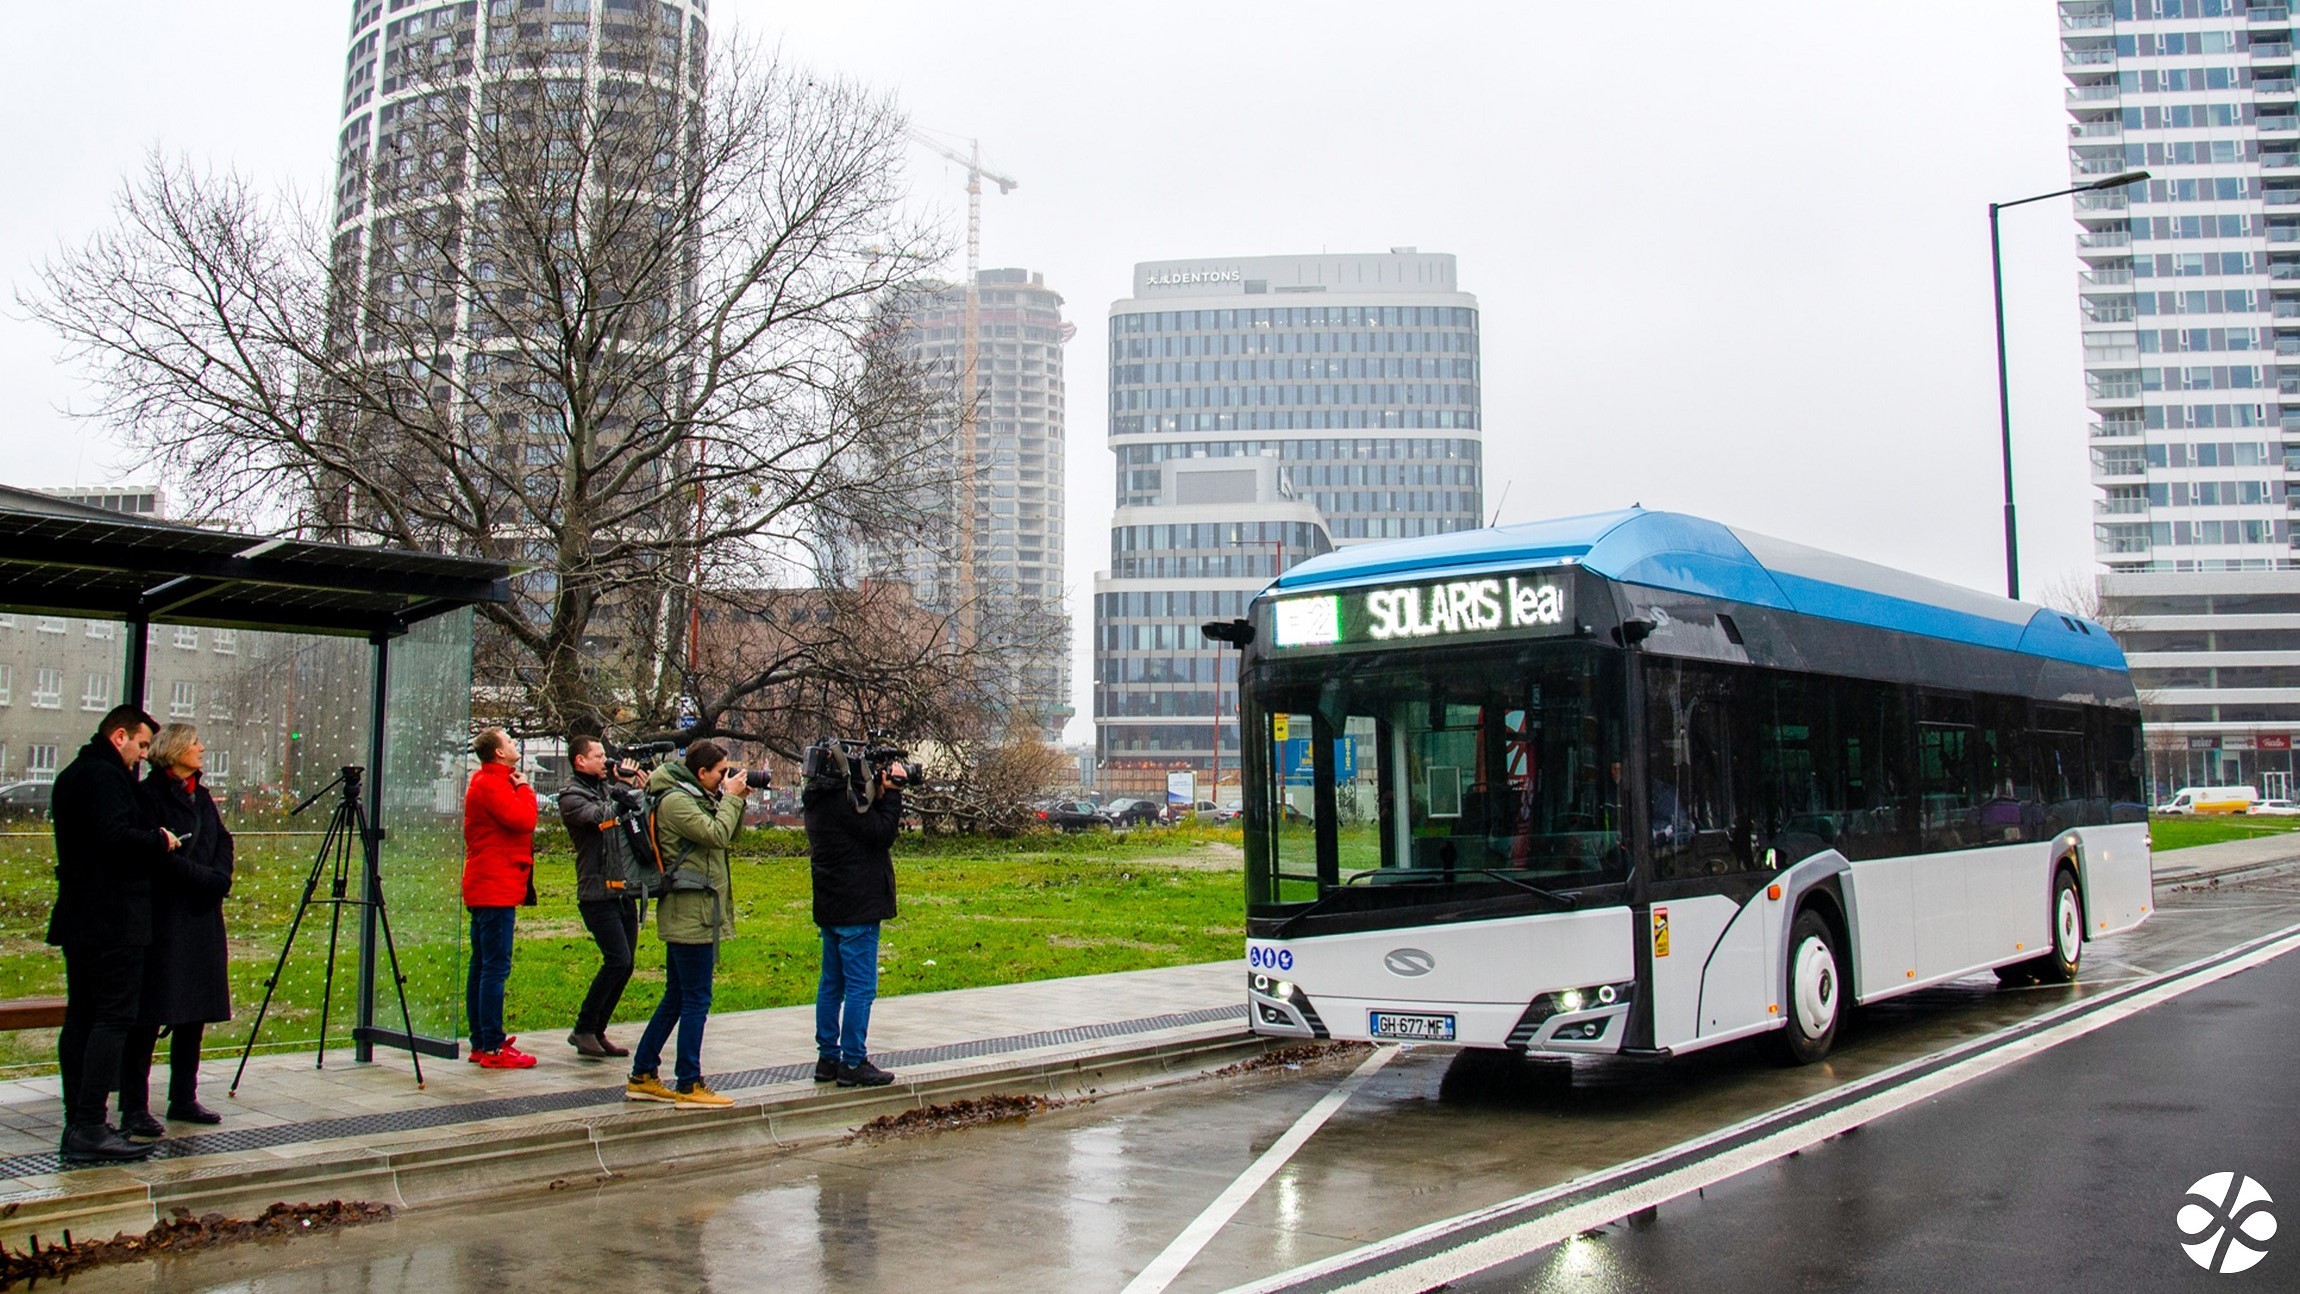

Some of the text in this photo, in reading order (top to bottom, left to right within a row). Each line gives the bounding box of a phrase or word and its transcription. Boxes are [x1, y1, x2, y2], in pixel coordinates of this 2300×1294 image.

[1172, 270, 1240, 284] DENTONS
[1366, 576, 1564, 641] SOLARIS lea
